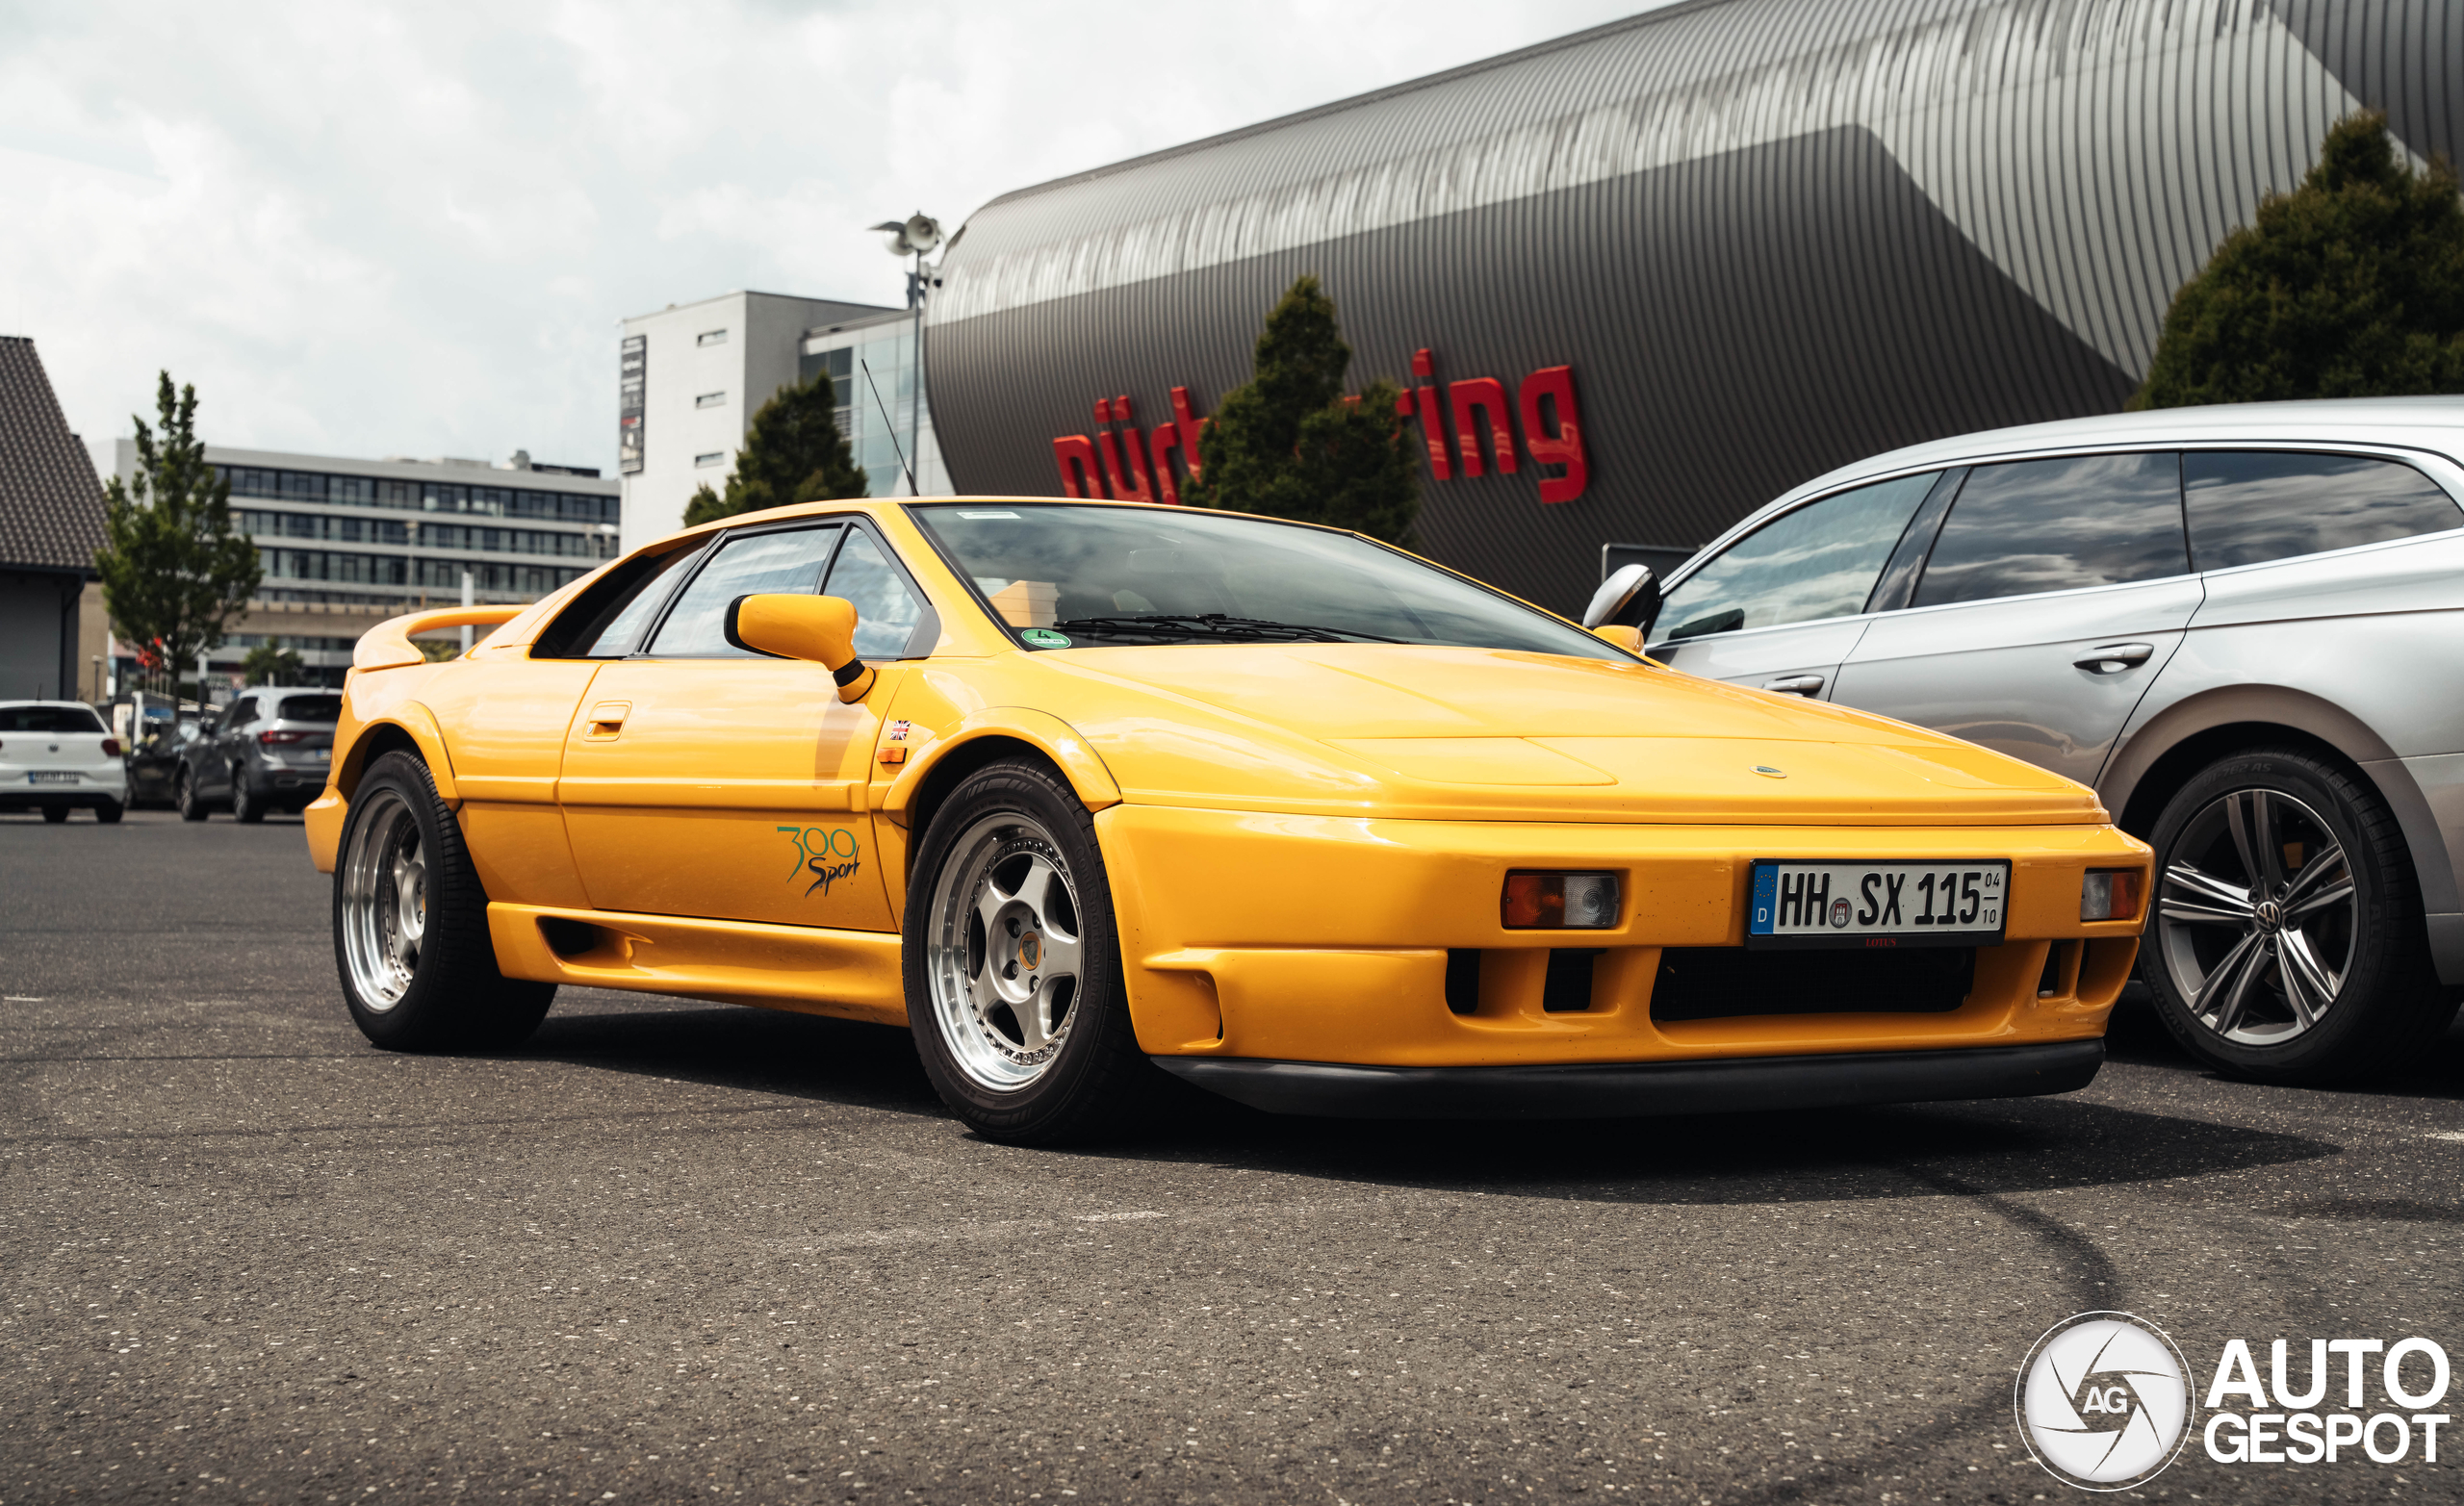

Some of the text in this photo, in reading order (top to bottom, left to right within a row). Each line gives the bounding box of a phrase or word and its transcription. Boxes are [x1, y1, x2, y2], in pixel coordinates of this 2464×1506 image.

[1053, 347, 1589, 505] nüring
[777, 826, 857, 883] 300
[805, 844, 861, 899] Sport
[1985, 872, 2000, 887] 04
[1757, 907, 1767, 923] D
[1779, 872, 1982, 927] HH SX 115
[1983, 908, 1997, 924] 10
[1865, 937, 1896, 947] LOTUS
